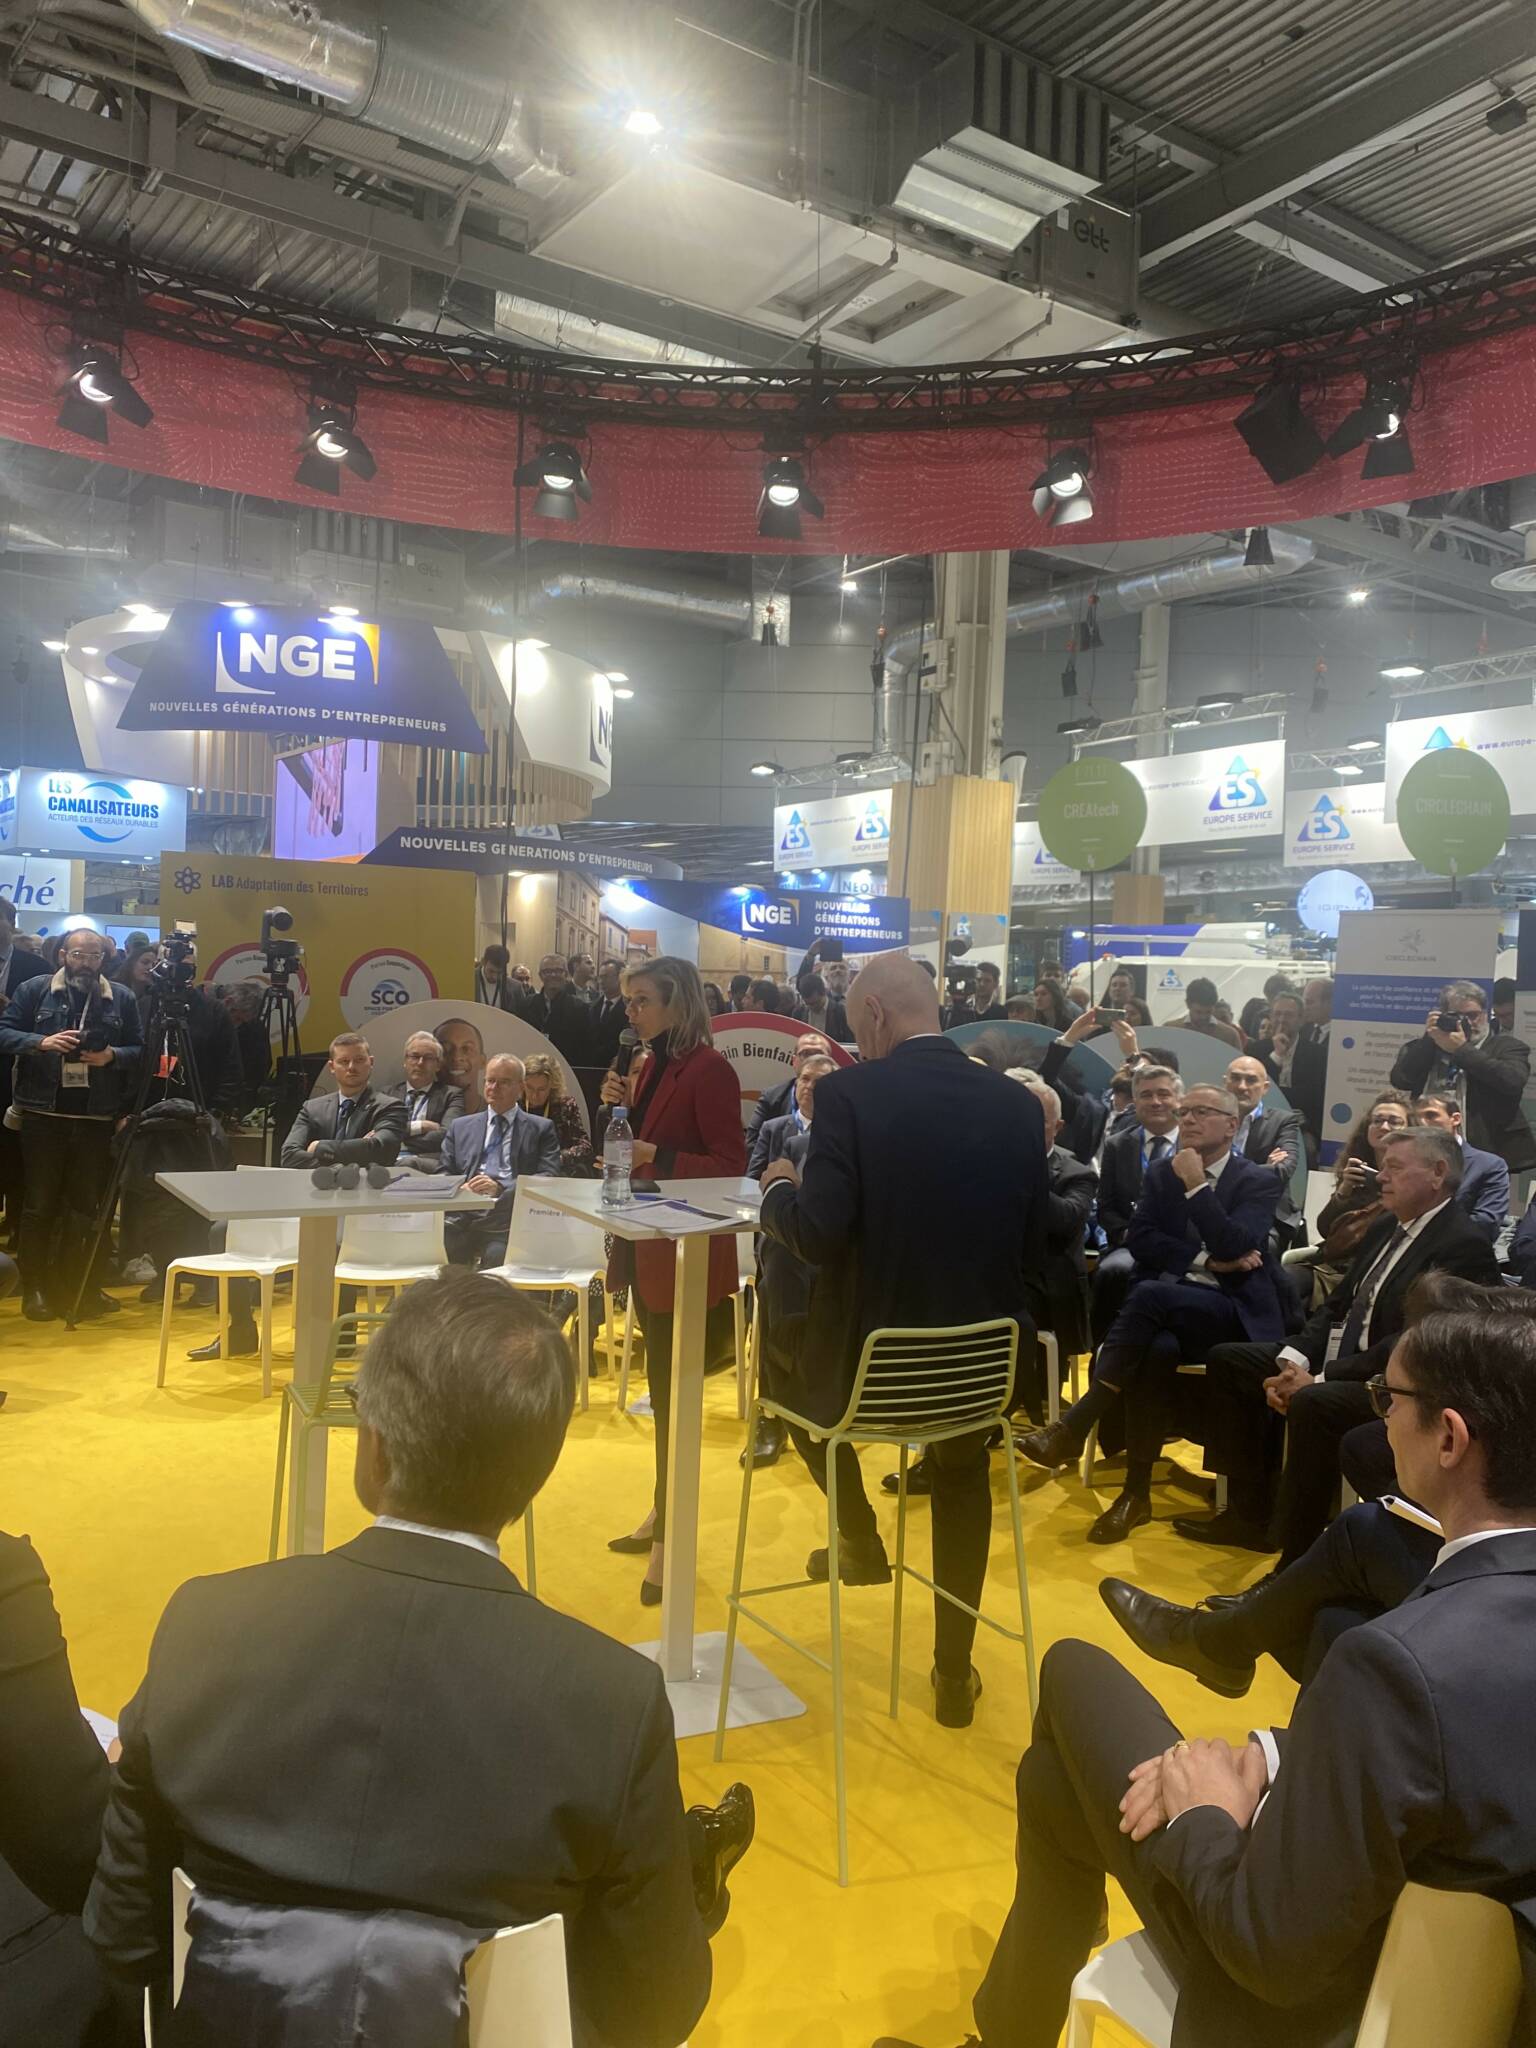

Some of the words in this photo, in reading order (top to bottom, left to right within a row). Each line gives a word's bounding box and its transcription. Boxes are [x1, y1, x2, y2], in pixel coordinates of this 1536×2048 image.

[238, 632, 356, 681] NGE
[150, 702, 218, 713] NOUVELLES
[223, 701, 317, 718] GÉNÉRATIONS
[322, 709, 447, 733] D'ENTREPRENEURS
[49, 779, 72, 794] LES
[1220, 770, 1257, 808] ES
[48, 796, 159, 819] CANALISATEURS
[1203, 813, 1235, 825] EUROPE
[1237, 811, 1273, 823] SERVICE
[1308, 810, 1341, 839] ES
[400, 836, 486, 854] NOUVELLES
[579, 852, 652, 873] D'ENTREPRENEURS
[212, 874, 233, 888] LAB
[236, 877, 293, 893] Adaptation
[296, 881, 313, 893] des
[317, 881, 369, 897] Territoires
[751, 903, 792, 925] NGE
[816, 911, 880, 926] GÉNÉRATIONS
[815, 926, 902, 939] D'ENTREPRENEURS
[371, 990, 410, 1005] SCO
